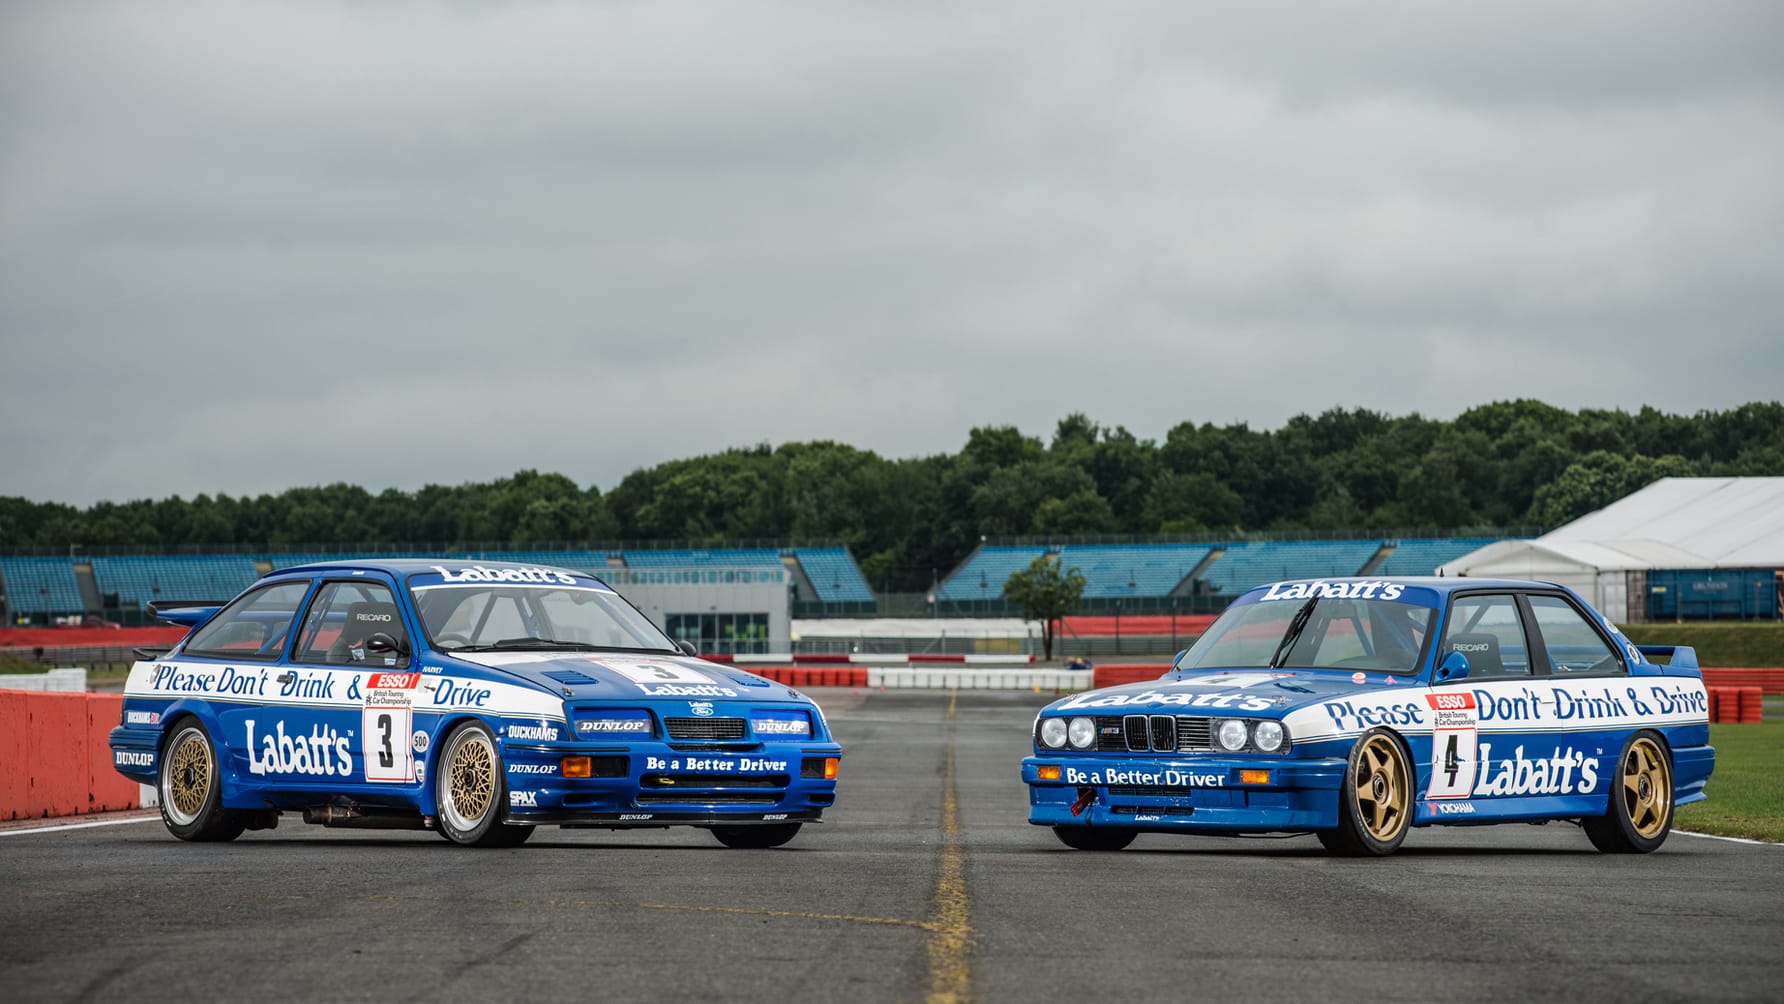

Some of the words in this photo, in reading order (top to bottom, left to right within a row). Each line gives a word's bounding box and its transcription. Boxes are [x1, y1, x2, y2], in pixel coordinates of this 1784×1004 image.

[430, 565, 577, 585] Labatt's
[1260, 580, 1405, 601] Labatt's
[356, 613, 392, 622] RECARO
[1453, 643, 1489, 651] RECARO
[636, 664, 681, 680] 3
[153, 665, 215, 691] Please
[216, 667, 268, 695] Don't
[280, 670, 336, 699] Drink
[347, 674, 362, 700] &
[433, 678, 491, 707] Drive
[377, 674, 409, 688] ESSO
[373, 690, 387, 698] British
[388, 690, 404, 699] Touring
[634, 683, 738, 697] Labatt's
[372, 696, 380, 704] Car
[380, 697, 412, 706] Championship
[1057, 690, 1275, 712] Labatt's
[1324, 701, 1424, 731] Please
[1472, 688, 1541, 721] Don't
[1551, 687, 1628, 719] Drink
[1626, 687, 1653, 716] &
[1650, 685, 1708, 715] Drive
[1436, 695, 1466, 709] ESSO
[1438, 711, 1452, 719] British
[1452, 711, 1468, 720] Touring
[1438, 718, 1446, 726] Car
[1446, 718, 1476, 727] Championship
[580, 721, 644, 731] DUNLOP
[757, 721, 806, 732] DUNLOP
[508, 725, 558, 742] DUCKHAMS
[245, 719, 352, 777] Labatt's
[377, 714, 394, 768] 3
[414, 735, 427, 748] 500
[116, 751, 154, 767] DUNLOP
[646, 757, 666, 770] Be
[670, 761, 679, 770] a
[686, 757, 734, 771] Better
[738, 758, 787, 772] Driver
[1444, 734, 1459, 788] 4
[508, 763, 557, 774] DUNLOP
[1473, 743, 1599, 797] Labatt's
[1066, 768, 1087, 784] Be
[1091, 772, 1101, 784] a
[1106, 768, 1162, 785] Better
[1165, 770, 1225, 787] Driver
[509, 791, 537, 804] SPAX
